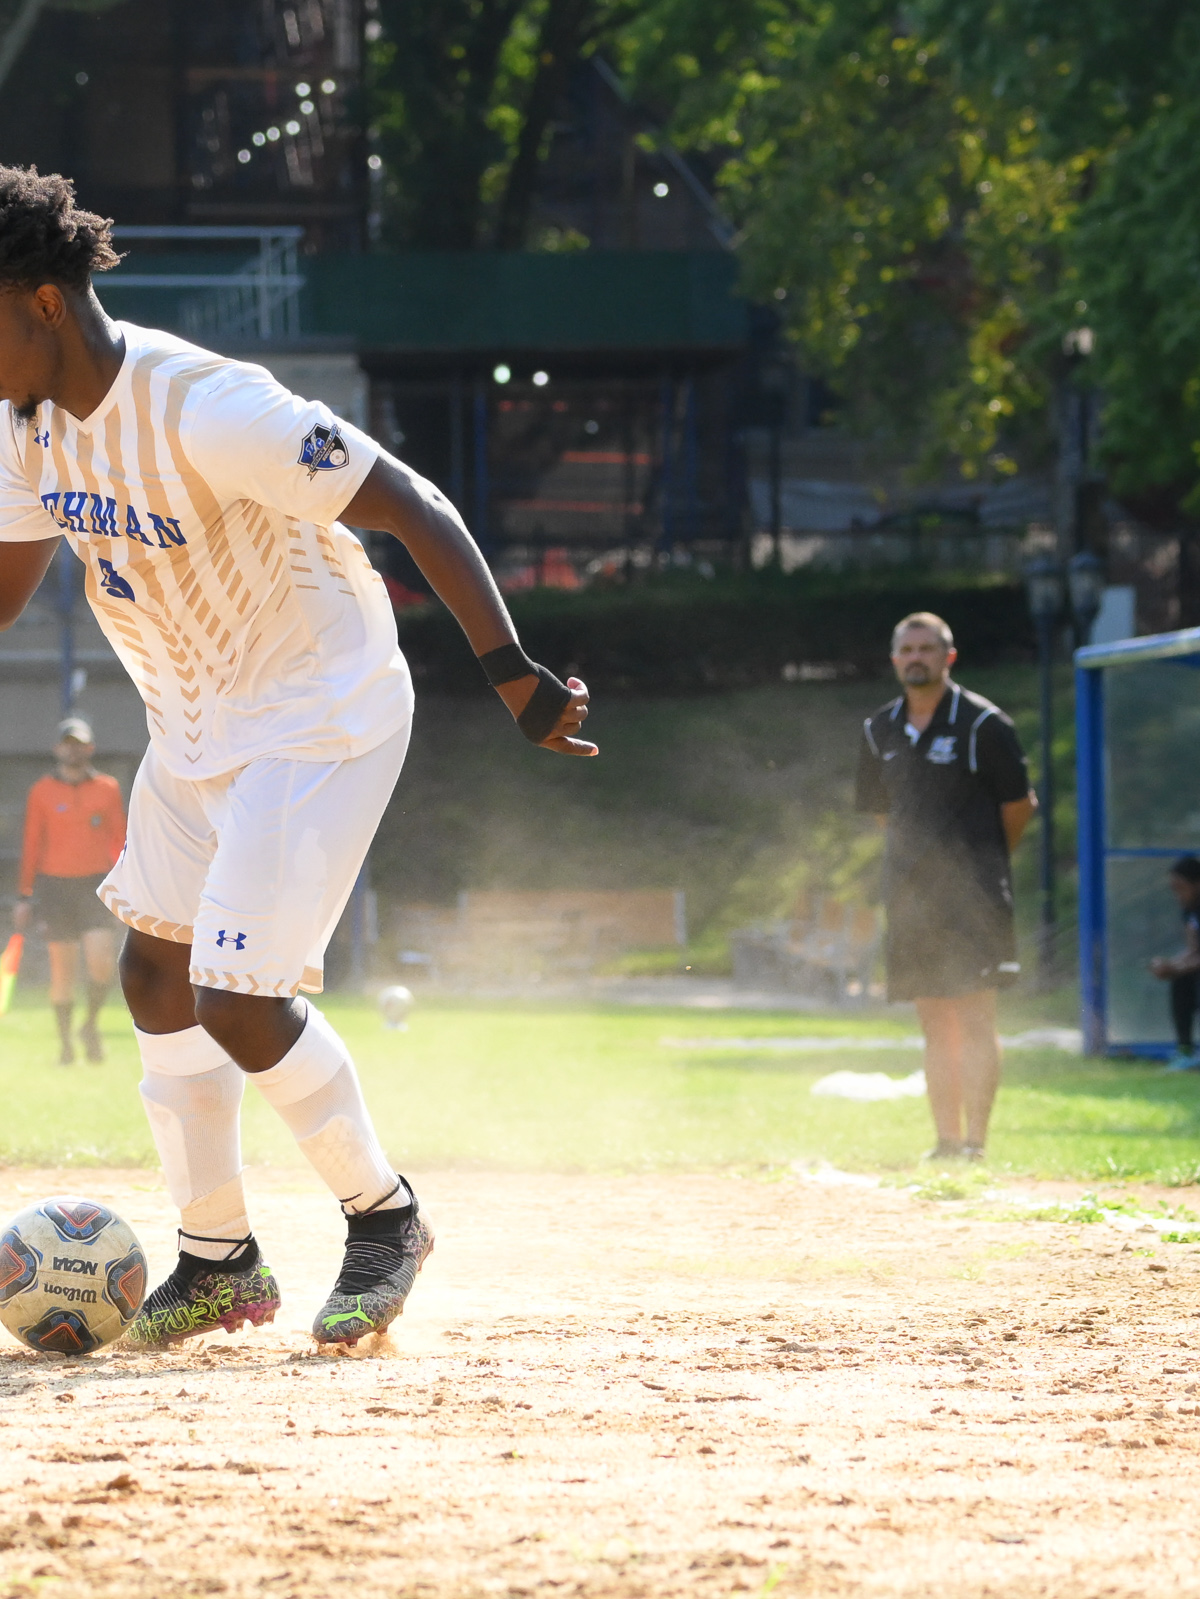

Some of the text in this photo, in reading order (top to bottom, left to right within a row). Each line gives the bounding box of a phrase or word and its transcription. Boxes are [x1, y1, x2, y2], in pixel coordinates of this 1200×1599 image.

[40, 491, 188, 549] EHMAN
[52, 1256, 99, 1276] NCAA
[43, 1281, 98, 1304] Wilson
